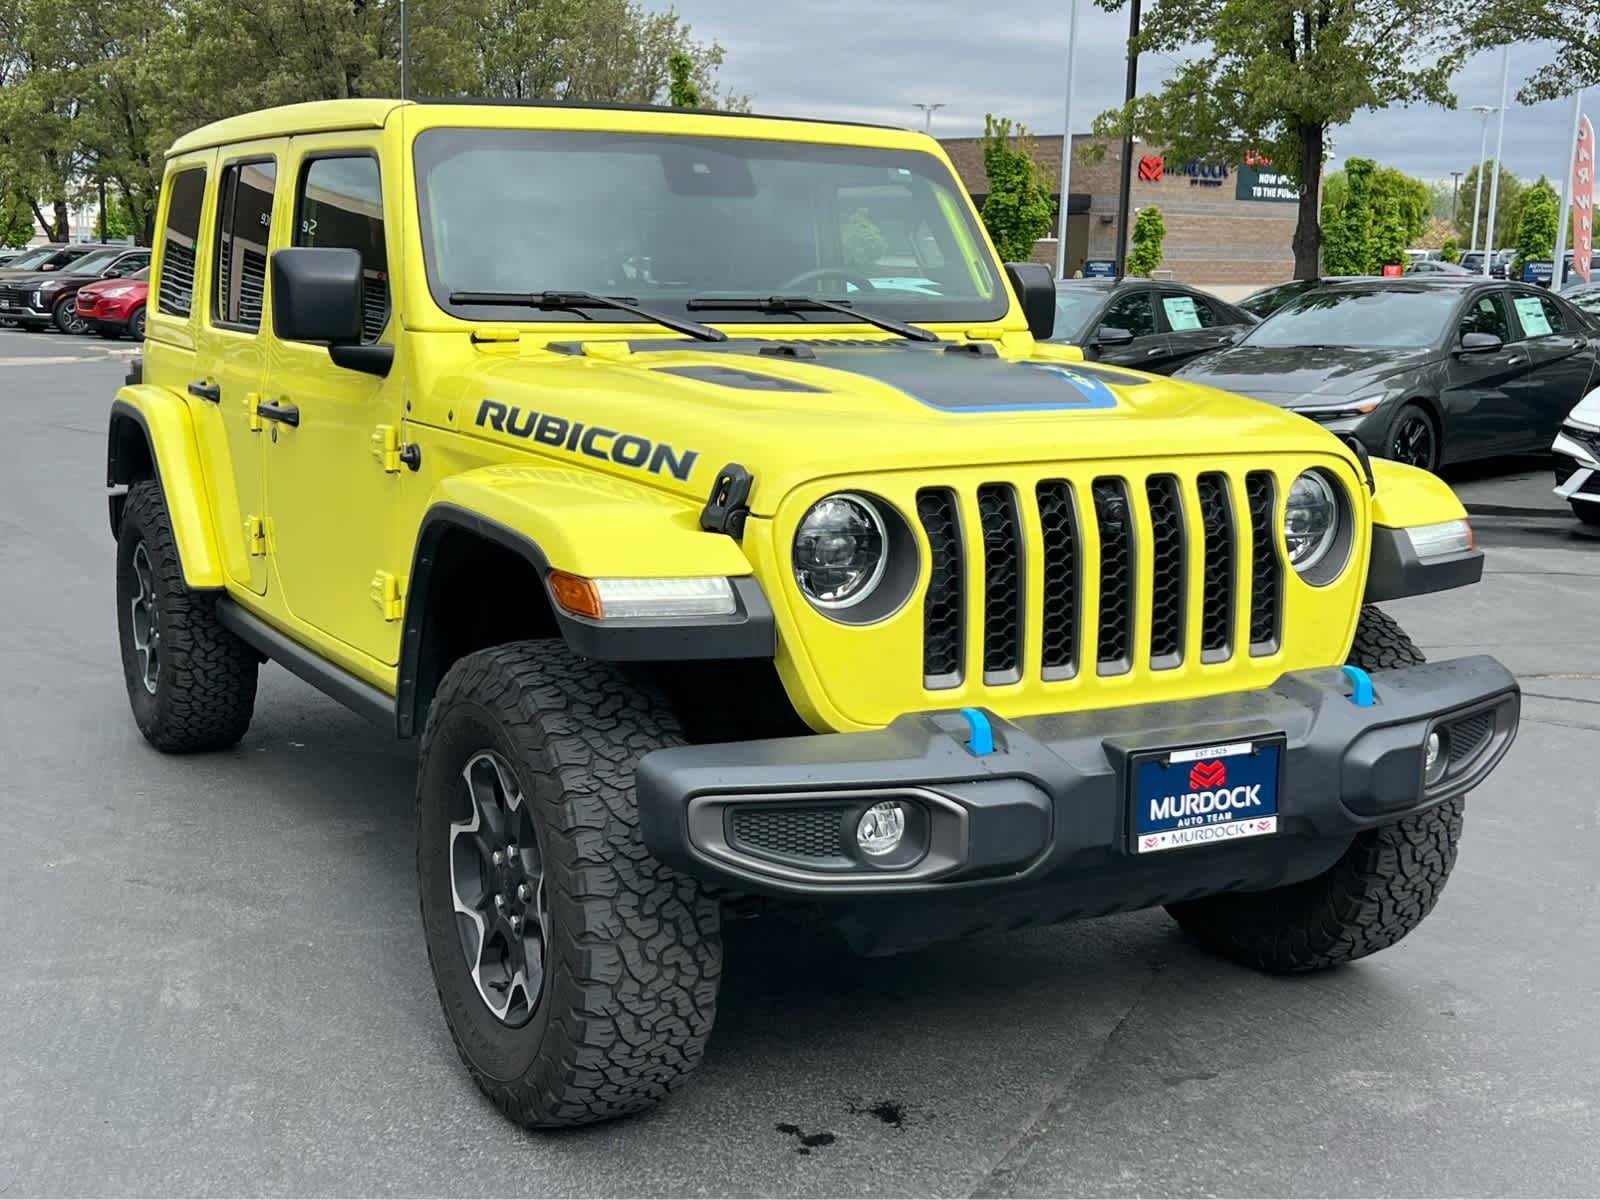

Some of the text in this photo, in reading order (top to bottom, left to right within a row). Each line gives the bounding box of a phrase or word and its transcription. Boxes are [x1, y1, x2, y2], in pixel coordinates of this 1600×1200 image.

[1258, 173, 1277, 184] NOW
[1252, 186, 1262, 197] TO
[1263, 187, 1276, 198] THE
[475, 399, 700, 481] RUBICON
[1150, 784, 1261, 820] MURDOCK
[1177, 812, 1232, 827] AUTO TEAM
[1171, 823, 1246, 844] MURDOCK
